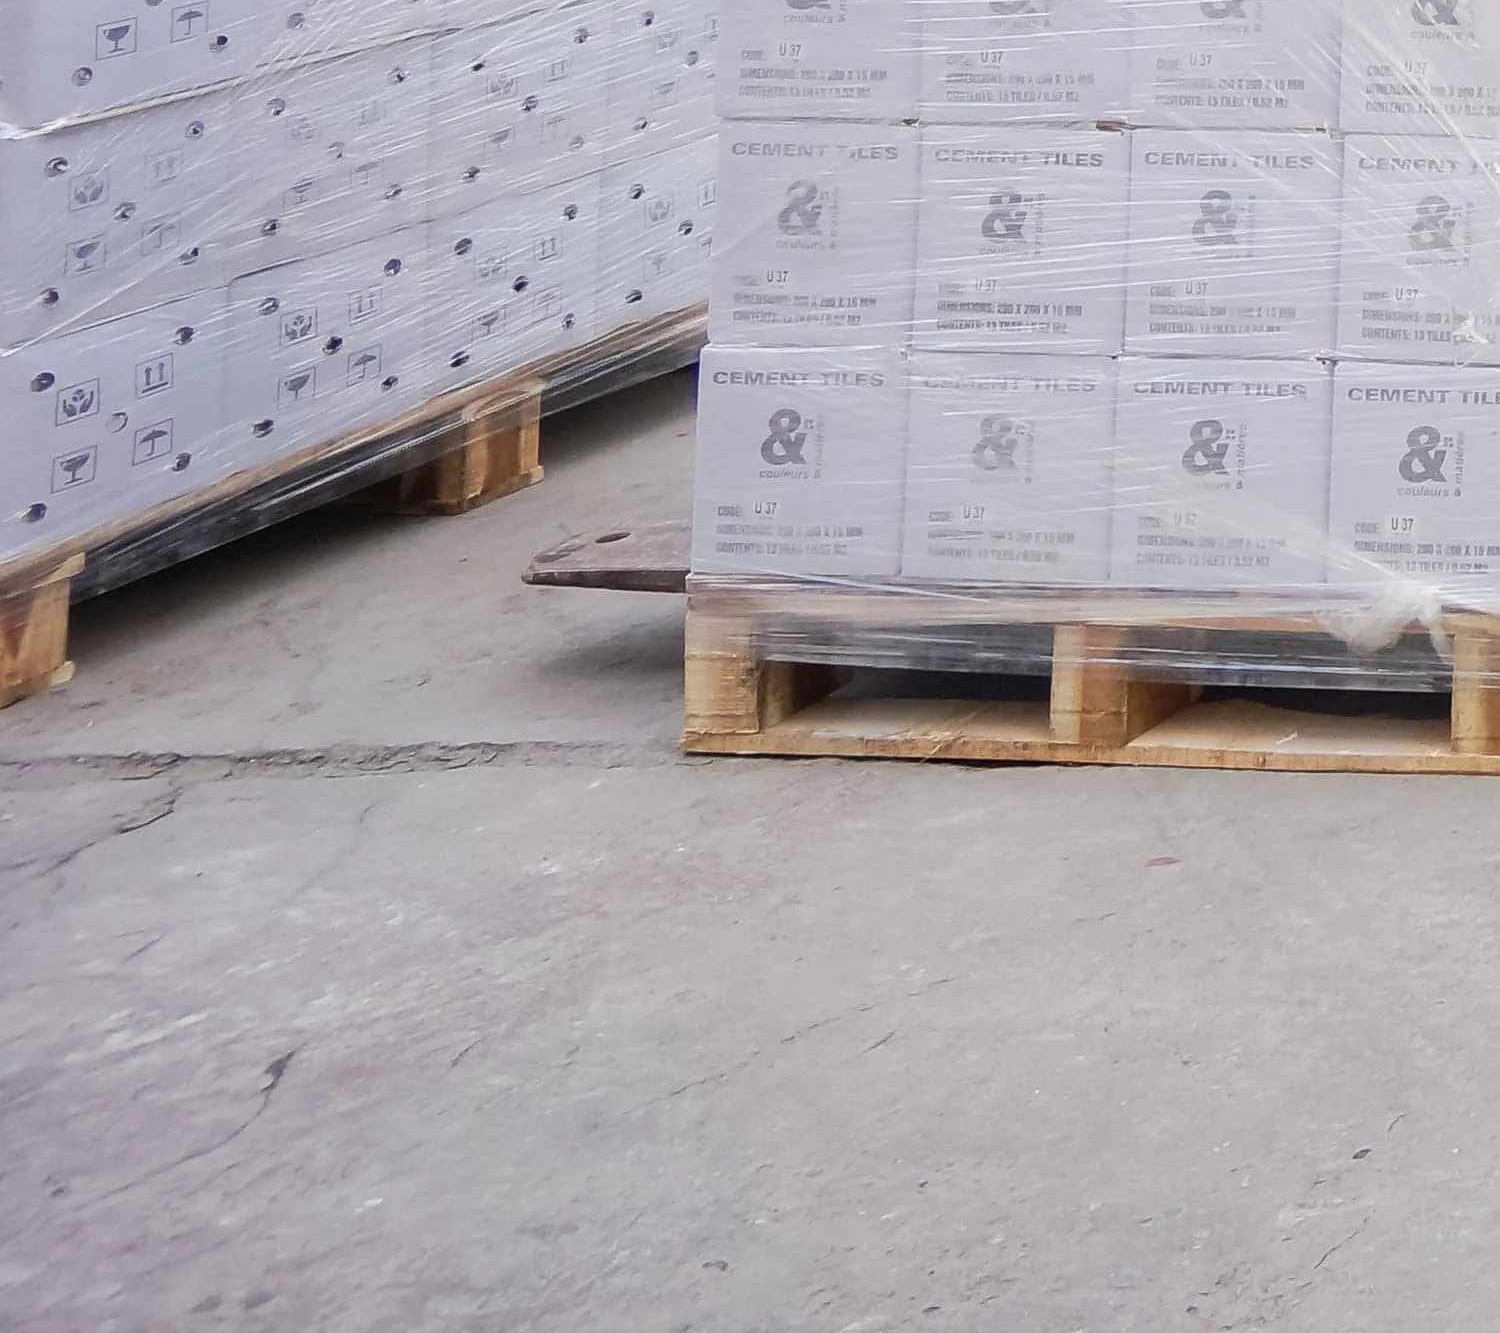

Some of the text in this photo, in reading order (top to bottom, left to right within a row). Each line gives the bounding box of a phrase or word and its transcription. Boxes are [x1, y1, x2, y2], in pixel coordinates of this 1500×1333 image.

[780, 44, 787, 57] U
[789, 44, 801, 57] 37
[981, 51, 1004, 64] U 37
[732, 143, 826, 158] CEMENT
[935, 149, 1103, 166] CEMENT TILES
[1144, 153, 1313, 169] CEMENT TILES
[767, 271, 789, 283] U 37
[1186, 282, 1193, 295] U
[1196, 282, 1207, 295] 37
[1396, 288, 1418, 301] U 37
[713, 372, 884, 387] CEMENT TILES
[1033, 378, 1095, 392] TILES
[1133, 382, 1306, 397] CEMENT TILES
[1348, 388, 1449, 404] CEMENT
[761, 408, 809, 465] &
[1182, 418, 1231, 475] &
[1398, 425, 1447, 484] &
[760, 468, 811, 480] couleurs
[1397, 486, 1449, 499] couleurs
[755, 502, 762, 515] U
[765, 502, 776, 515] 37
[964, 507, 984, 519] U 37
[1392, 518, 1399, 531] U
[1402, 518, 1414, 531] 37
